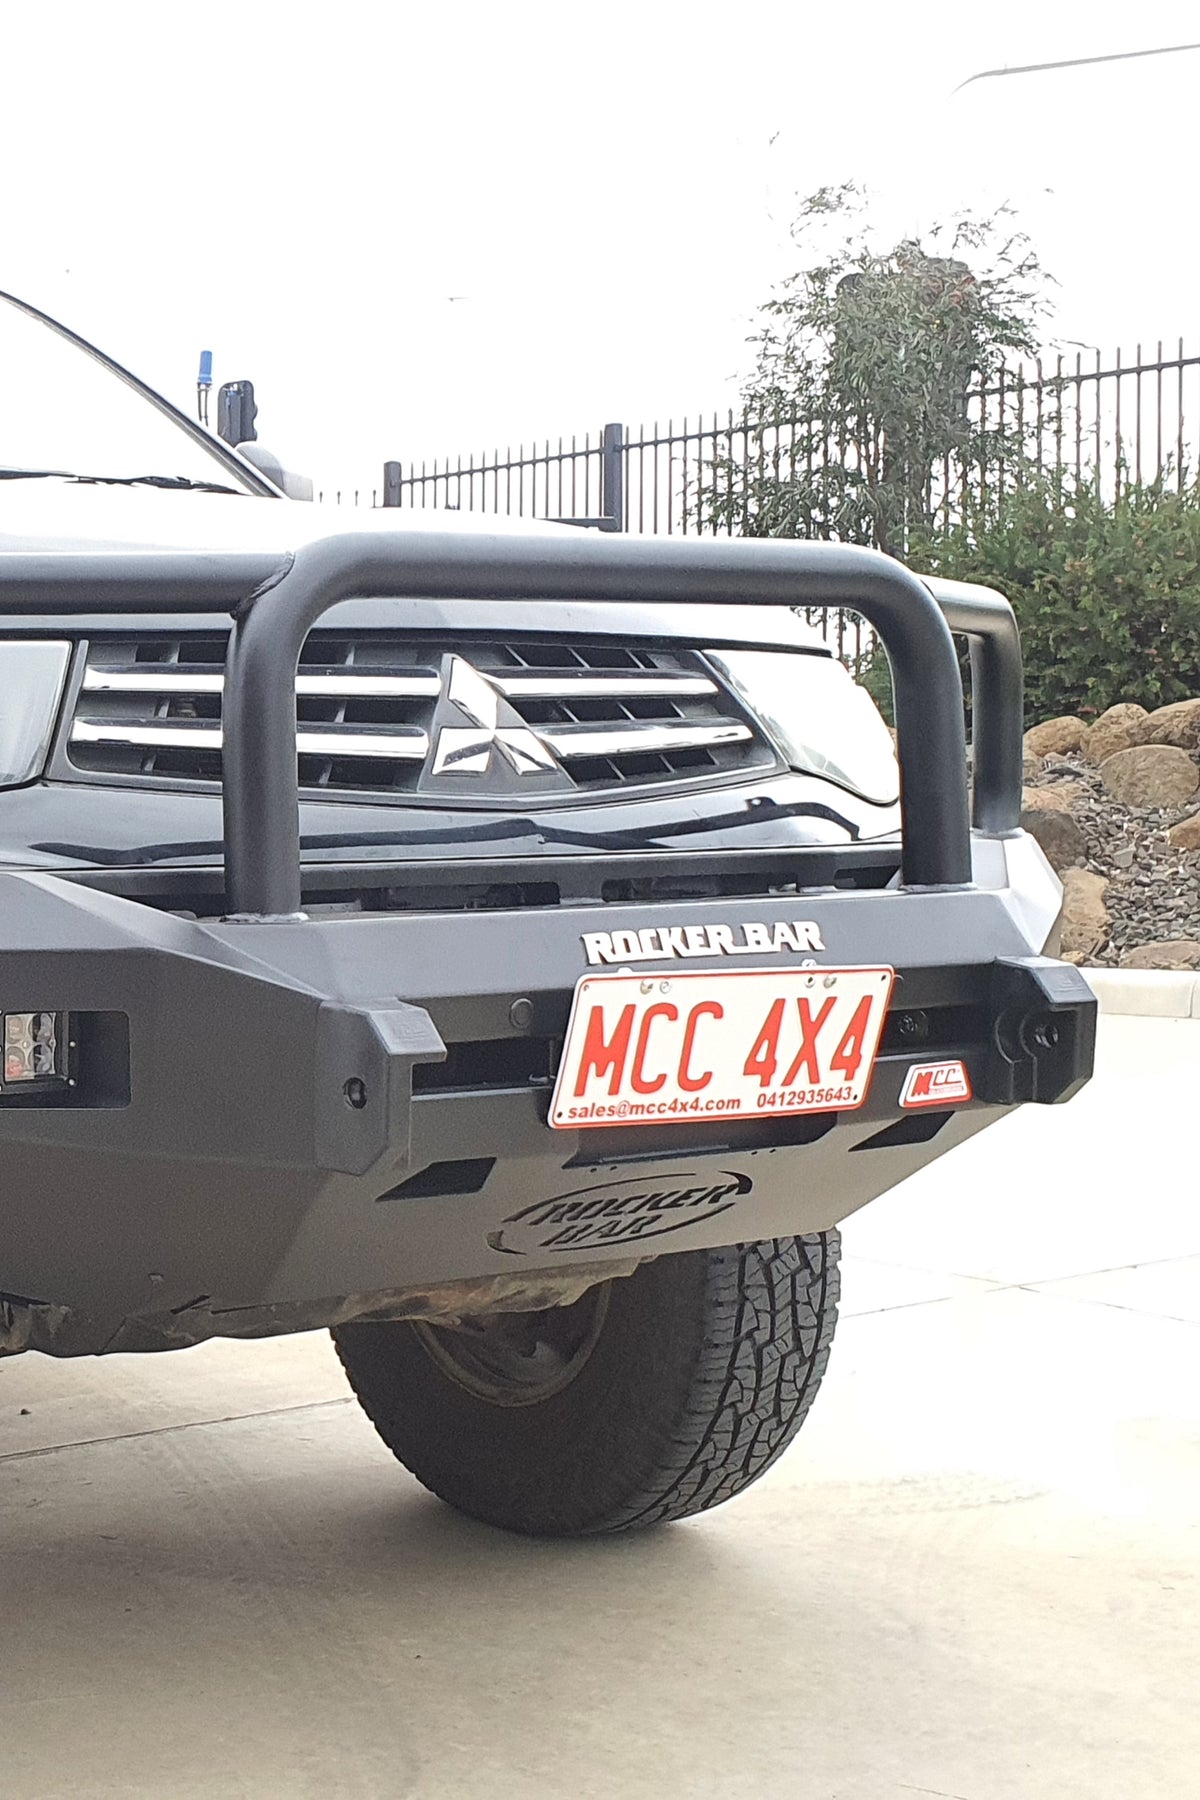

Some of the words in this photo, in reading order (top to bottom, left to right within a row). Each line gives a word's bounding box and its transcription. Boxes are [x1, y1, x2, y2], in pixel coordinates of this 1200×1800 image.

[581, 924, 738, 966] ROCKER
[742, 920, 826, 954] BAR
[573, 1002, 724, 1097] MCC
[743, 994, 873, 1088] 4X4
[567, 1098, 741, 1119] sales@mcc4x4.com
[756, 1087, 853, 1108] 0412935643
